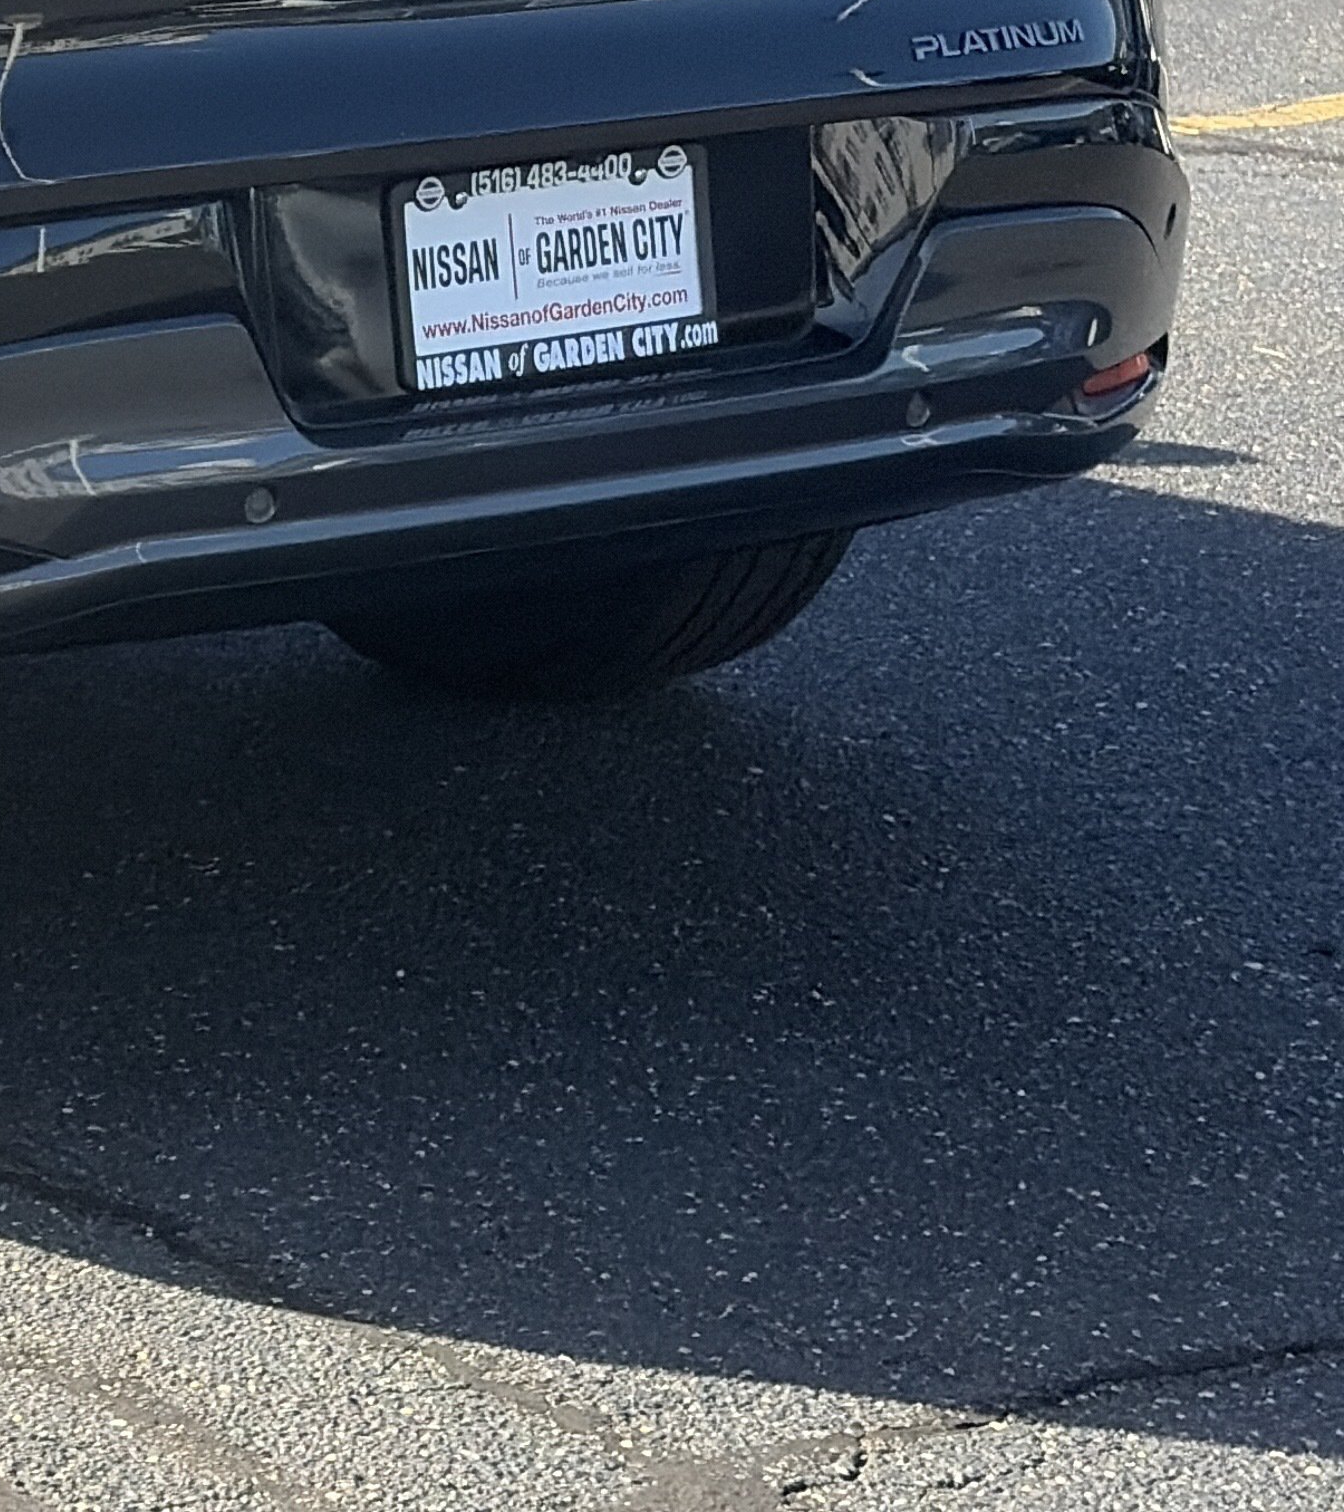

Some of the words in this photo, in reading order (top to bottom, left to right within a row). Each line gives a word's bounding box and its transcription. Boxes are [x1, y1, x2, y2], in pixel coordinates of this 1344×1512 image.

[911, 18, 1086, 61] PLATINUM
[470, 163, 522, 197] (516)
[534, 216, 554, 226] The
[609, 202, 647, 217] Nissan
[648, 197, 683, 212] Dealer
[412, 238, 500, 291] NISSAN
[518, 247, 531, 266] OF
[535, 222, 629, 275] GARDEN
[632, 213, 684, 261] CITY
[536, 274, 590, 289] Because
[592, 271, 610, 281] we
[422, 288, 689, 339] www.NissanofGardenCity.com
[416, 348, 503, 390] NISSAN
[508, 343, 529, 376] of
[533, 331, 625, 372] GARDEN
[631, 320, 719, 357] CITY.com
